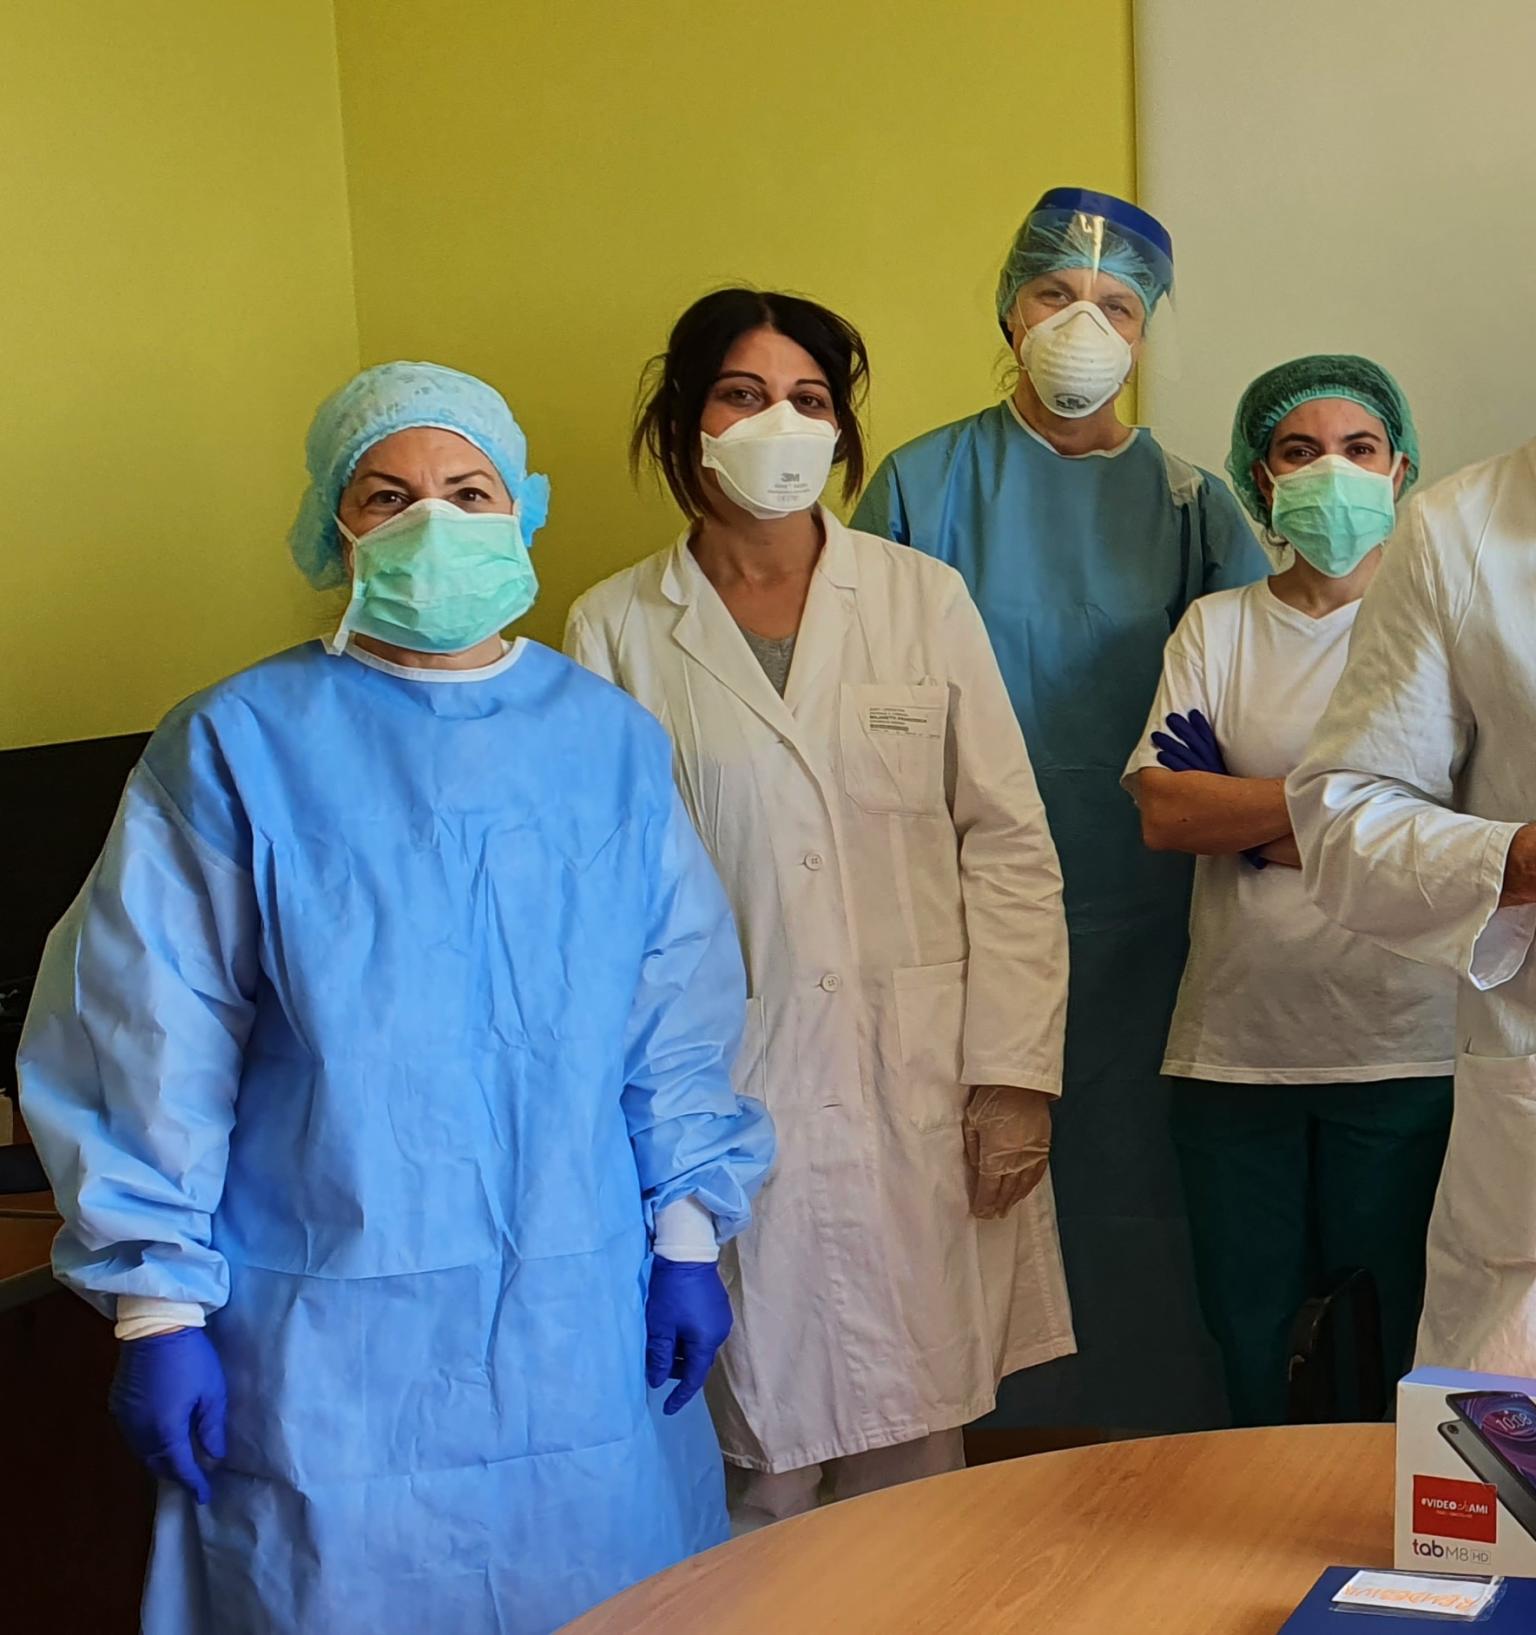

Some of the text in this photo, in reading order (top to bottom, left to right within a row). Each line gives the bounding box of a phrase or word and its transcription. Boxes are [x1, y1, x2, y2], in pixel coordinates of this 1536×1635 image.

[780, 472, 800, 483] 3M
[1412, 1538, 1444, 1558] tab
[1472, 1551, 1489, 1563] HD
